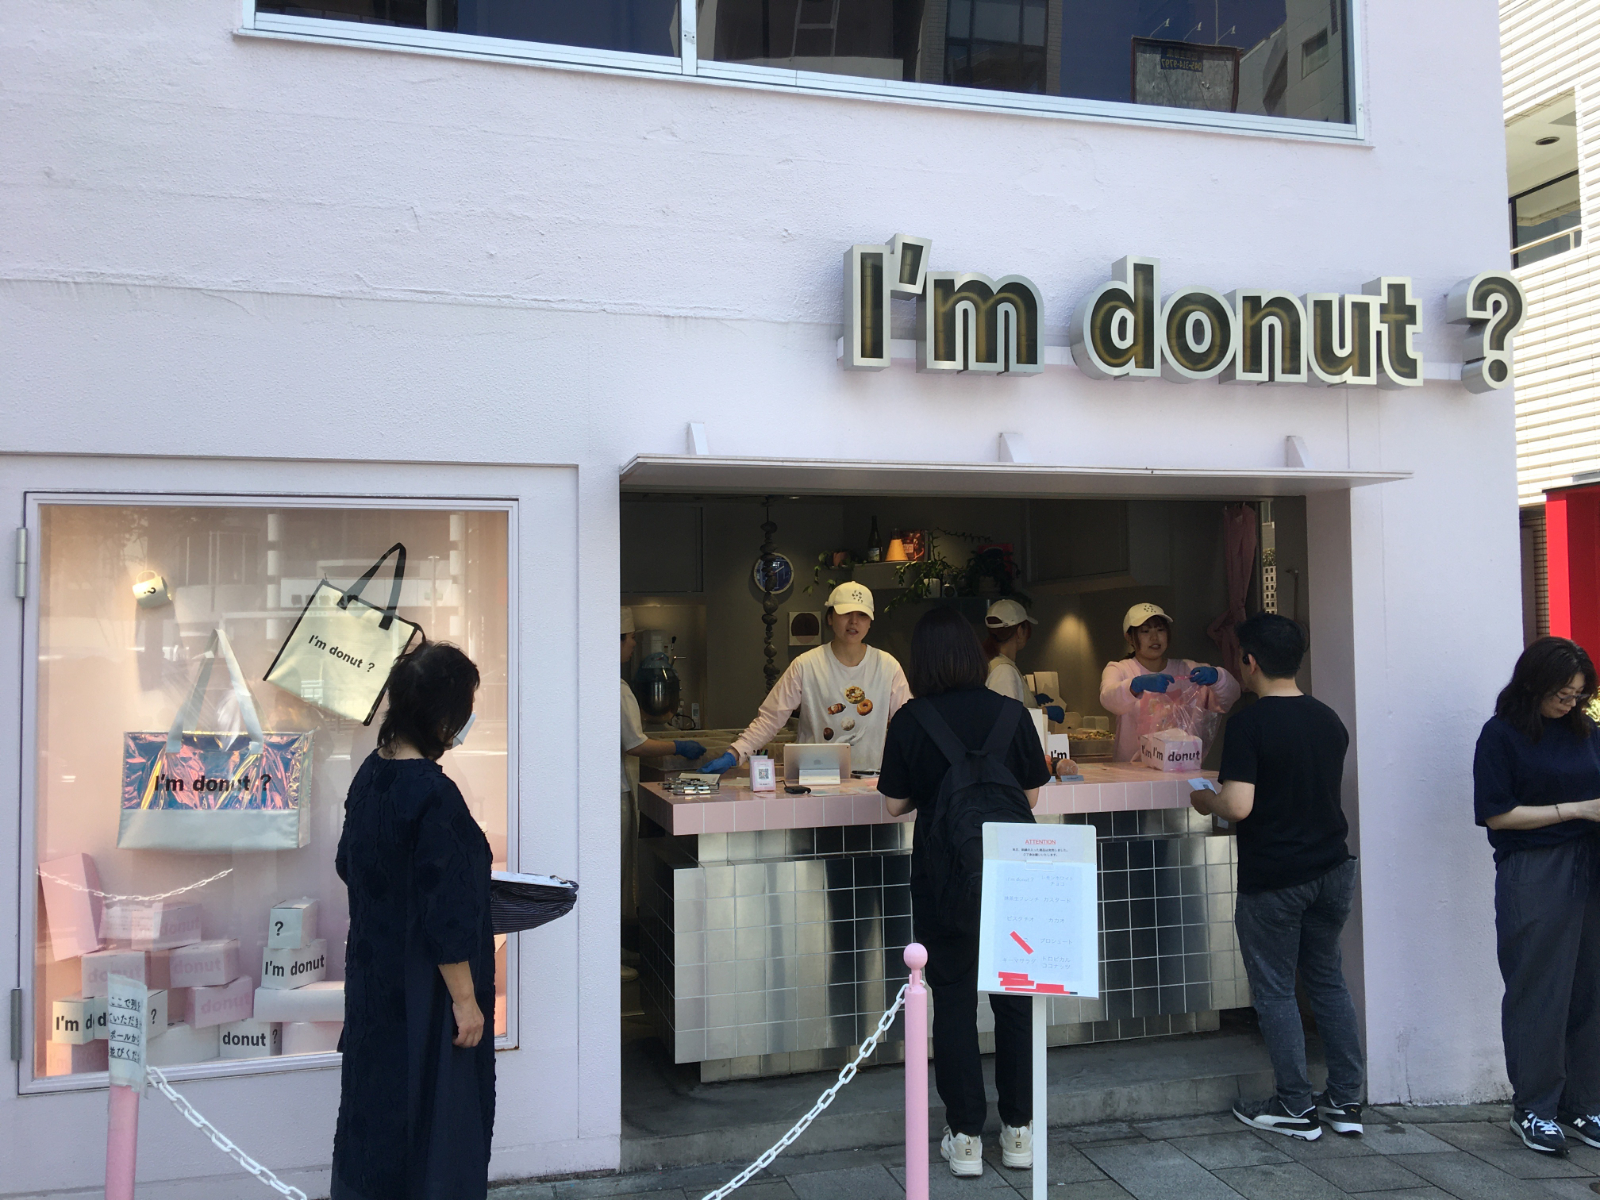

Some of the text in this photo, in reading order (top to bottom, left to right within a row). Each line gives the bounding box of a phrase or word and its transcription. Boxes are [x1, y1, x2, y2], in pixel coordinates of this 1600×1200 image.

[845, 233, 1526, 391] I'm donut ?
[308, 634, 376, 673] I'm donut ?
[1153, 746, 1201, 762] I'm donut
[154, 774, 272, 792] I'm donut ?
[274, 921, 284, 936] ?
[174, 958, 221, 974] donut
[264, 954, 325, 977] I'm donut
[201, 992, 251, 1014] donut
[56, 1015, 79, 1032] I'm
[150, 1008, 157, 1024] ?
[222, 1029, 278, 1046] donut ?
